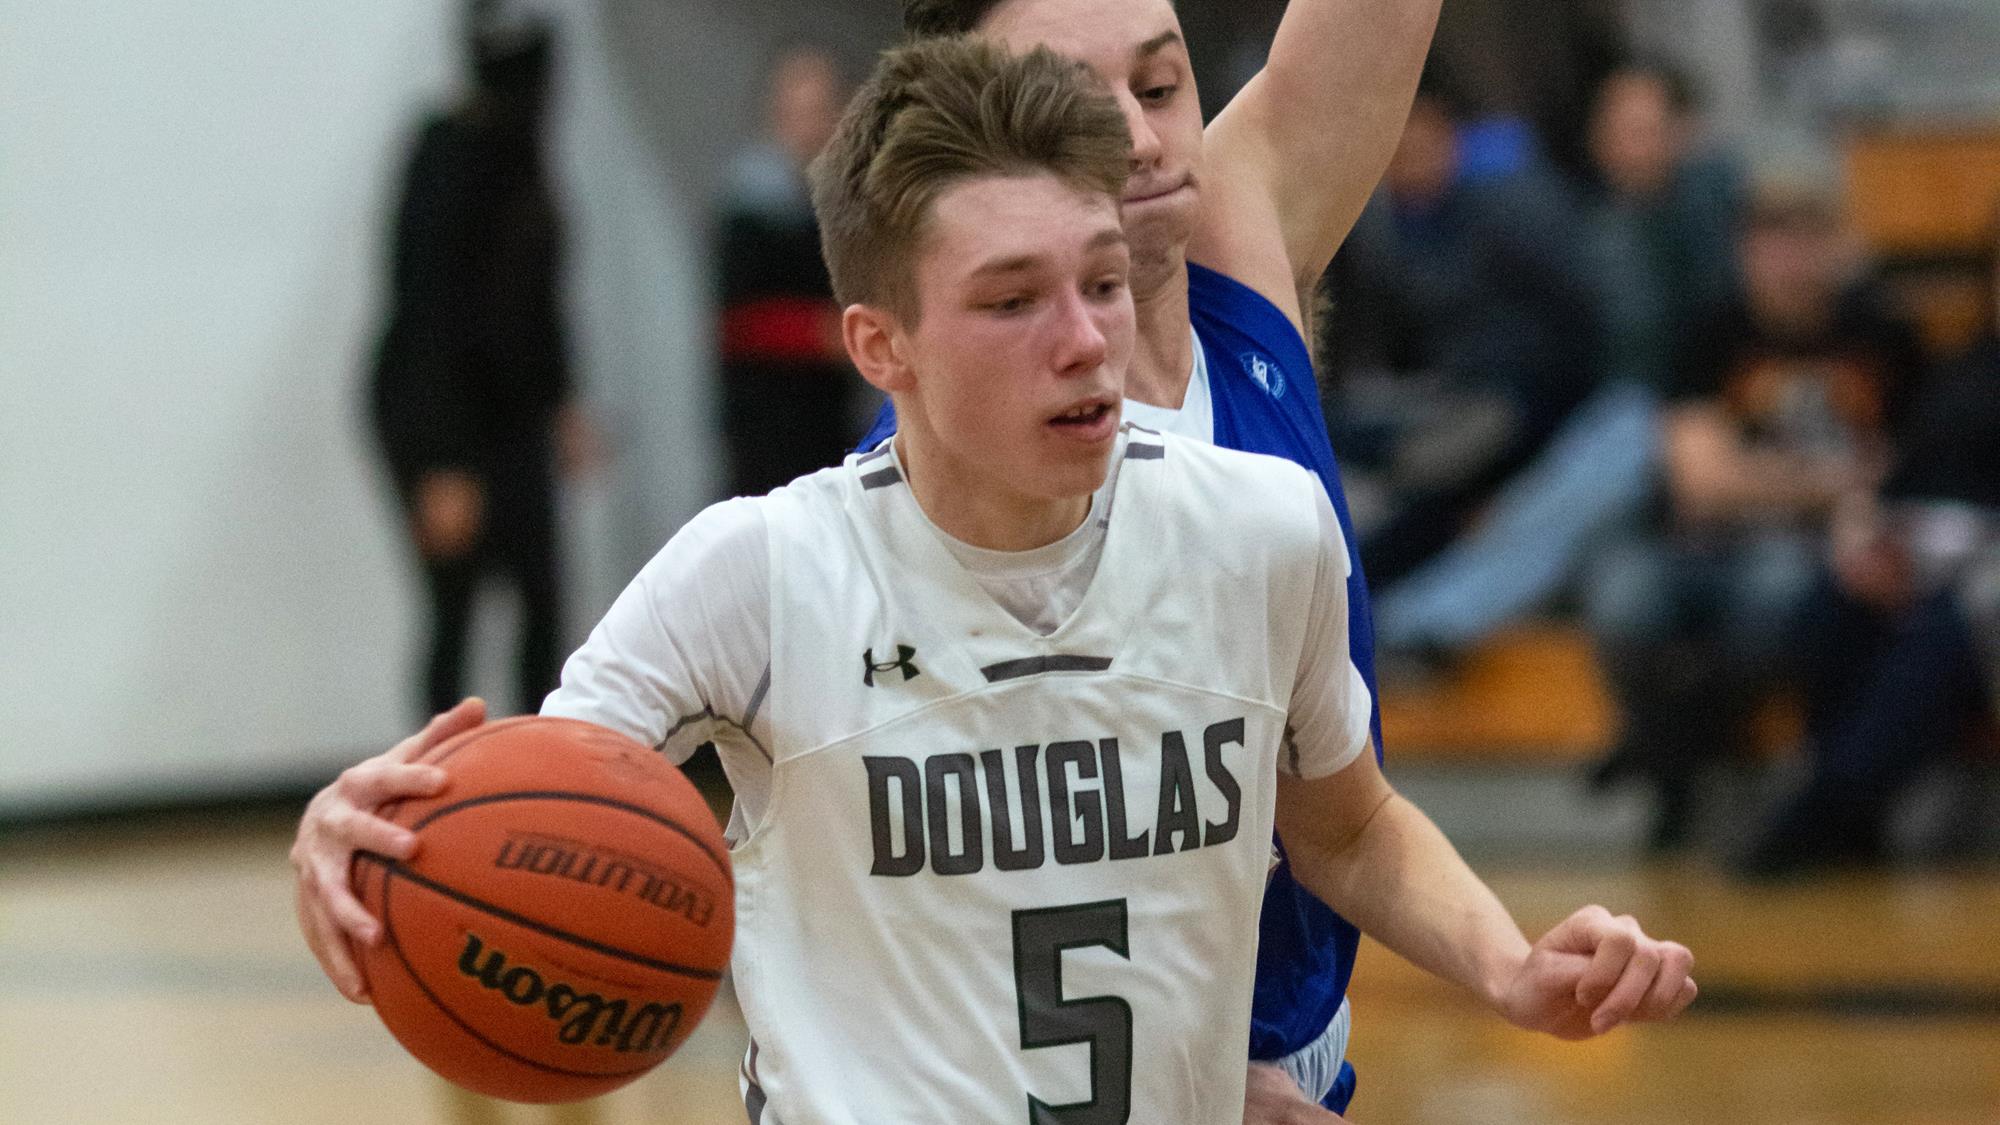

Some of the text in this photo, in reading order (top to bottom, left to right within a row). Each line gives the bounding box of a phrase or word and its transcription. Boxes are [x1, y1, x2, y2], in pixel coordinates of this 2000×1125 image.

[861, 717, 1245, 877] DOUGLAS
[495, 838, 715, 928] EVOLUTION
[457, 933, 684, 1053] Wilson
[1011, 897, 1133, 1125] 5
